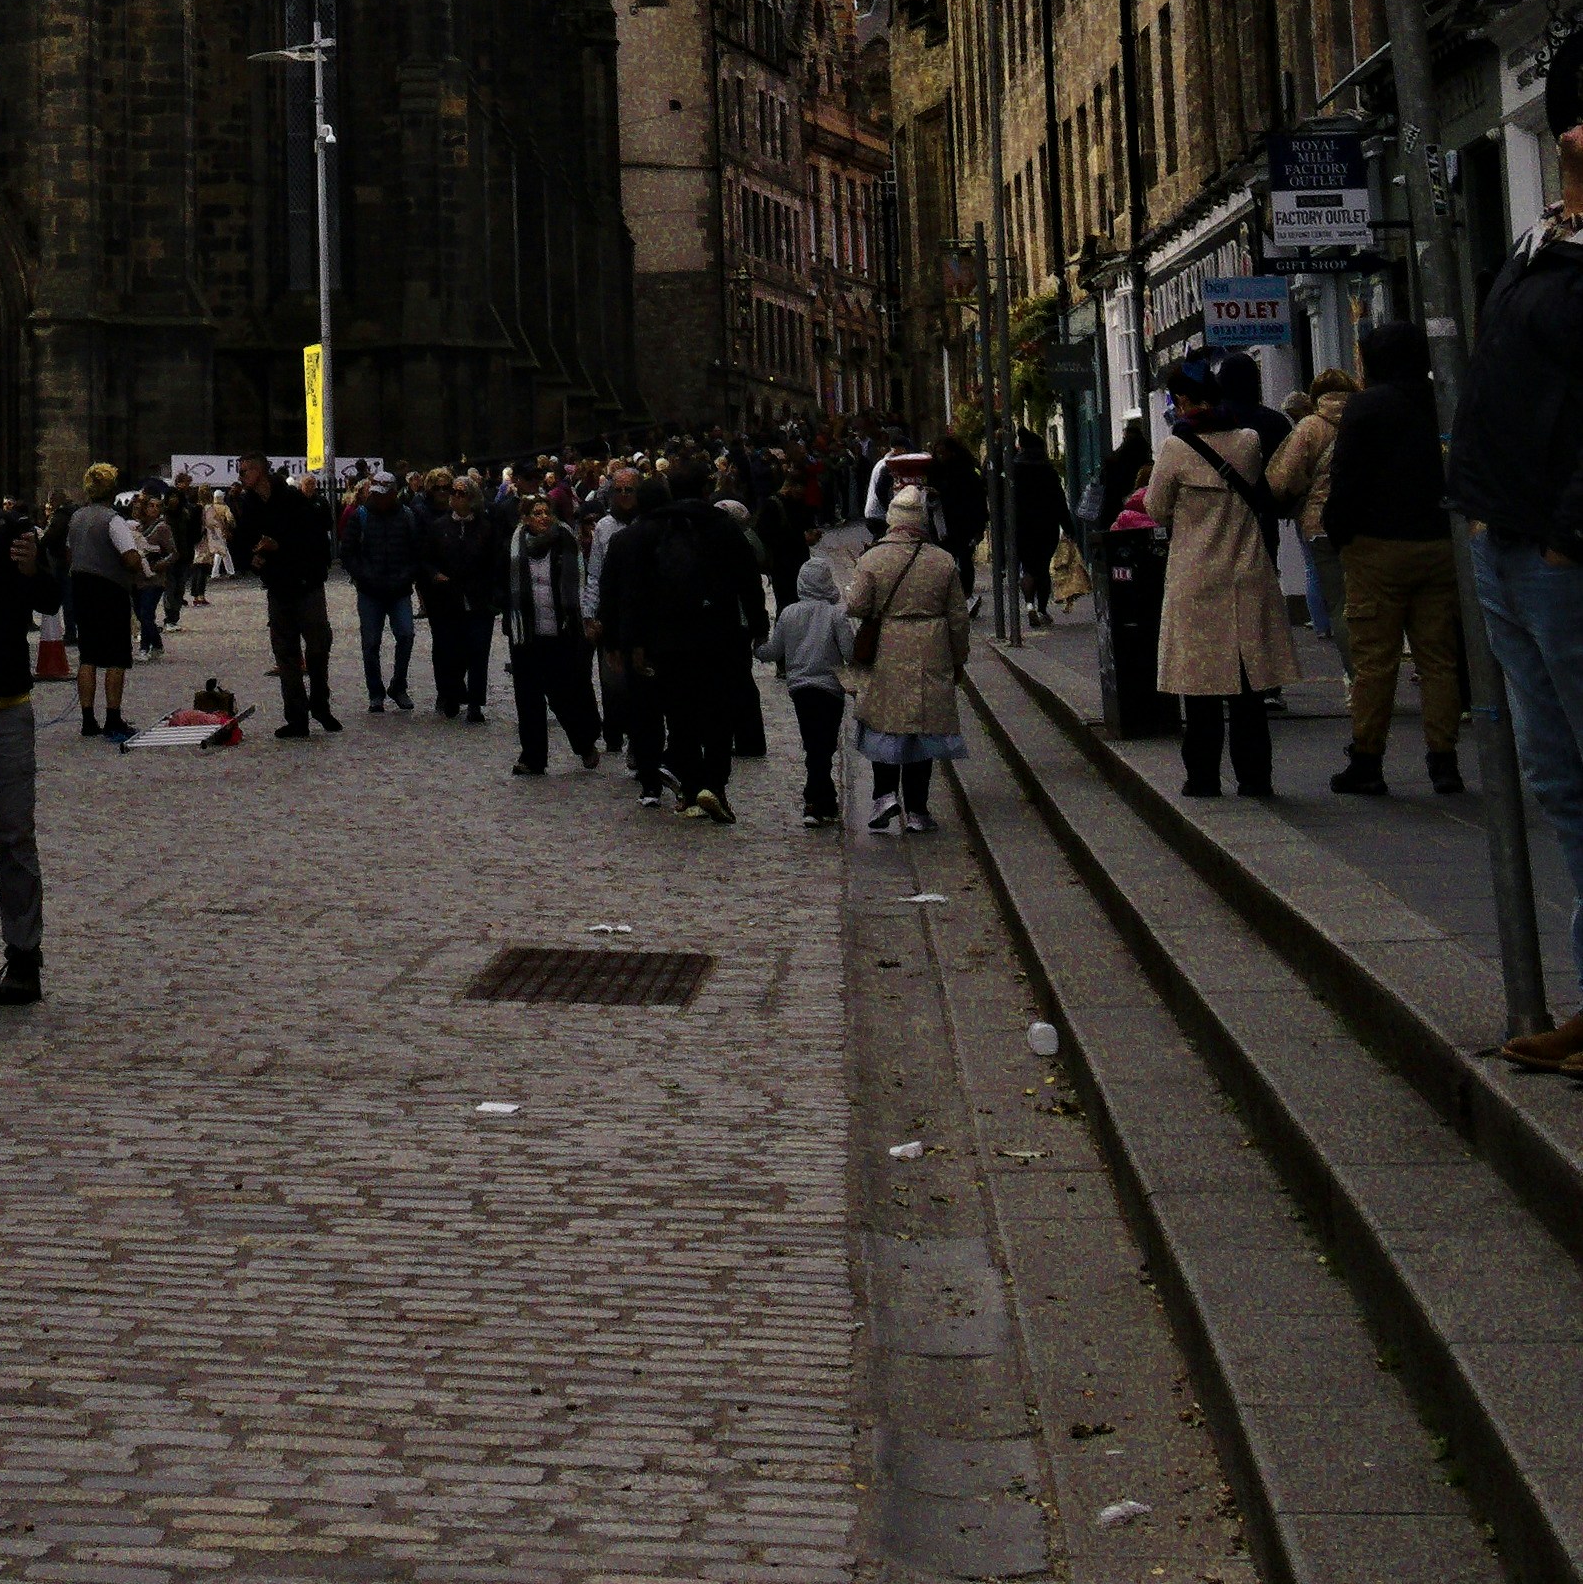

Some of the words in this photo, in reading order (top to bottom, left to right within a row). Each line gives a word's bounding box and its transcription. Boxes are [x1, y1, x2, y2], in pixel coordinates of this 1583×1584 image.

[1291, 140, 1339, 151] ROYAL
[1298, 152, 1334, 163] MILE
[1284, 163, 1349, 175] FACTORY
[1289, 174, 1347, 187] OUTLET
[1275, 210, 1322, 225] FACTORY
[1325, 209, 1367, 224] OUTLET
[1276, 260, 1306, 271] GIFT
[1311, 260, 1348, 271] SHOP
[1213, 302, 1241, 319] TO
[1245, 301, 1279, 319] LET
